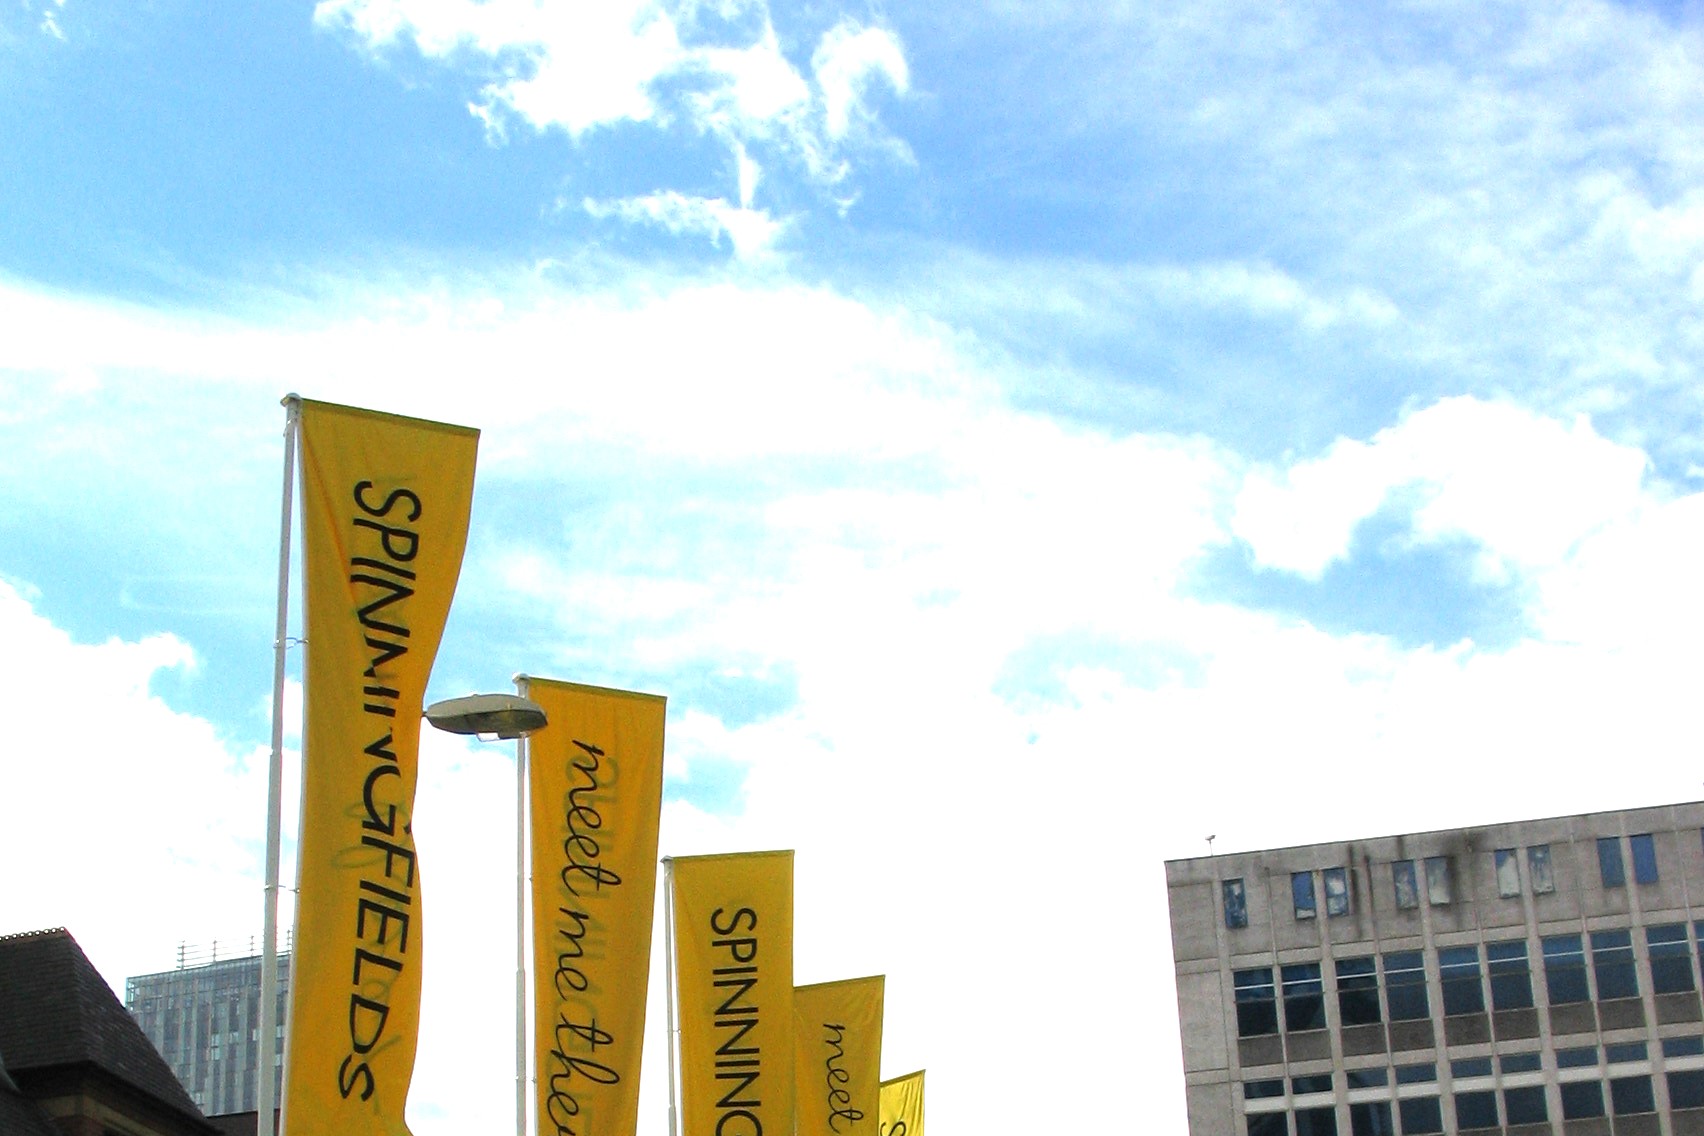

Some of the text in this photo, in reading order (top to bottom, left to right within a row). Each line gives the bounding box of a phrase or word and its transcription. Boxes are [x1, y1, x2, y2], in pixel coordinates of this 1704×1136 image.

[561, 739, 622, 897] meet
[554, 907, 590, 1001] me
[823, 1024, 864, 1135] meet
